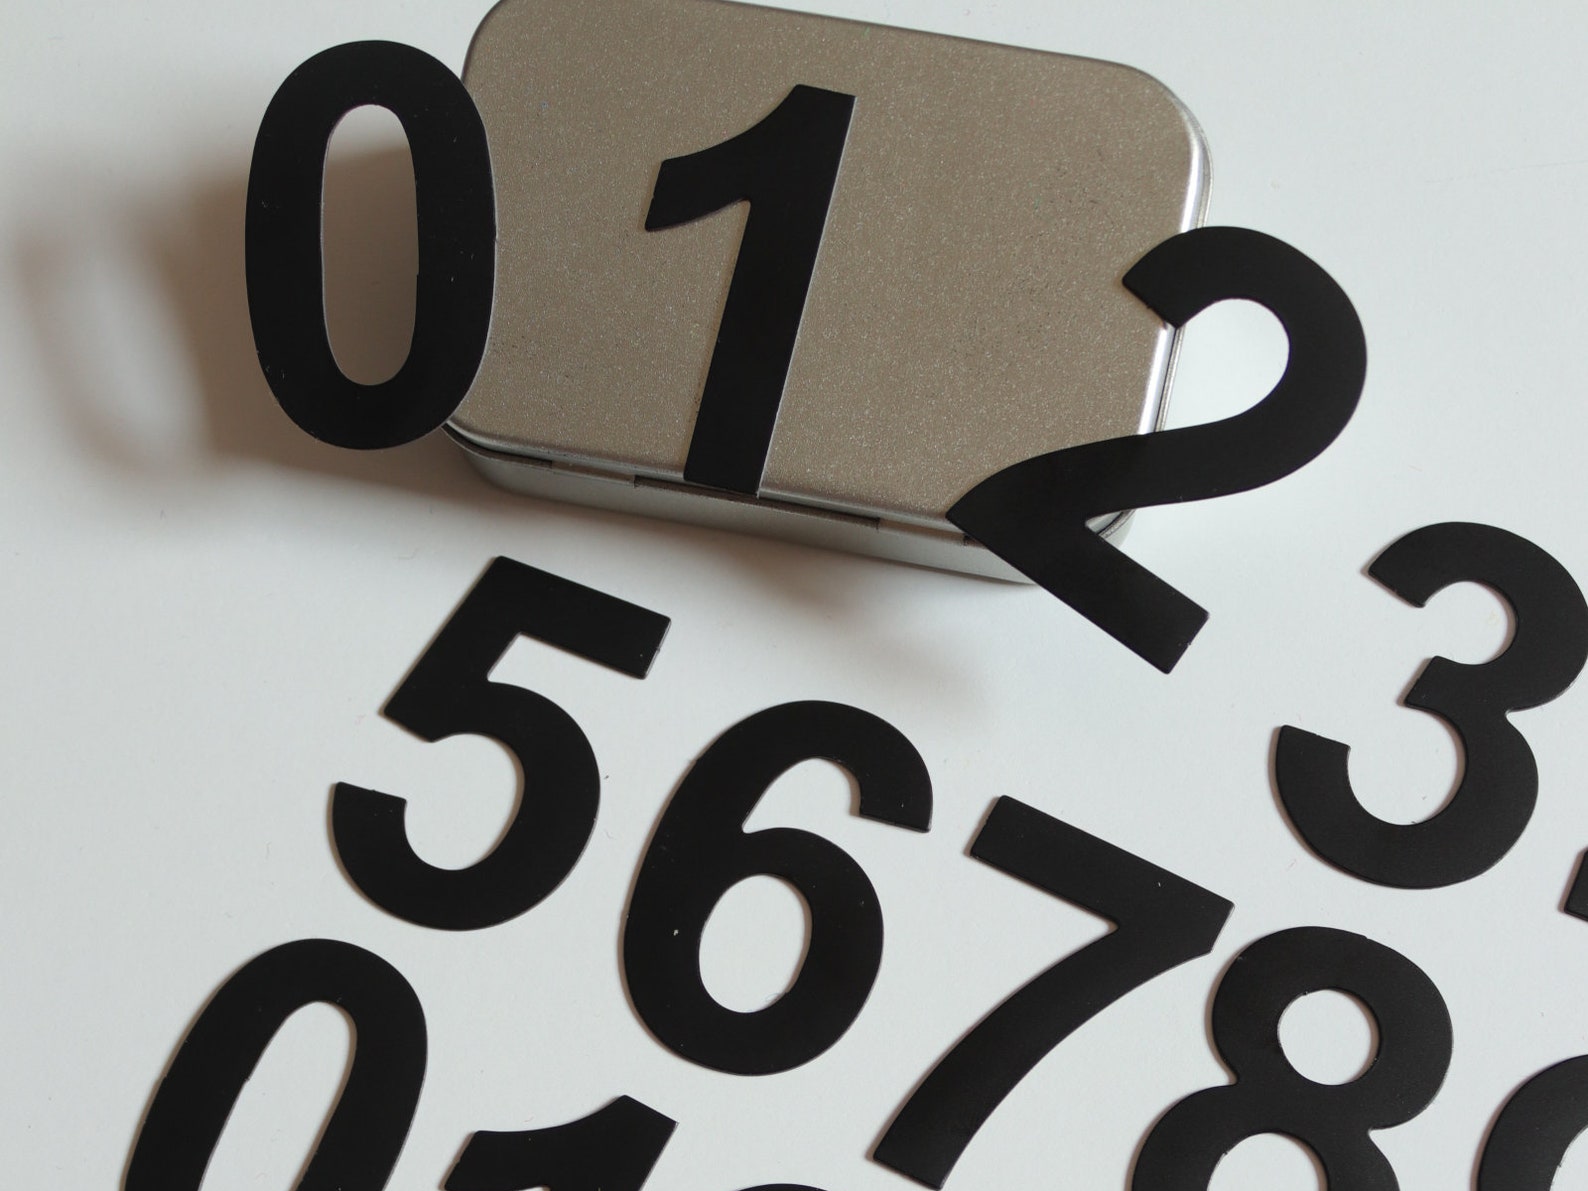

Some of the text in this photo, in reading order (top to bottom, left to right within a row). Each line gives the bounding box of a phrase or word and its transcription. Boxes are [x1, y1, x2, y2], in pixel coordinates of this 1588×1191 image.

[245, 41, 1588, 889] 0 1 2 3
[332, 556, 670, 930] 5
[623, 701, 932, 1075] 6
[873, 796, 1232, 1190] 7
